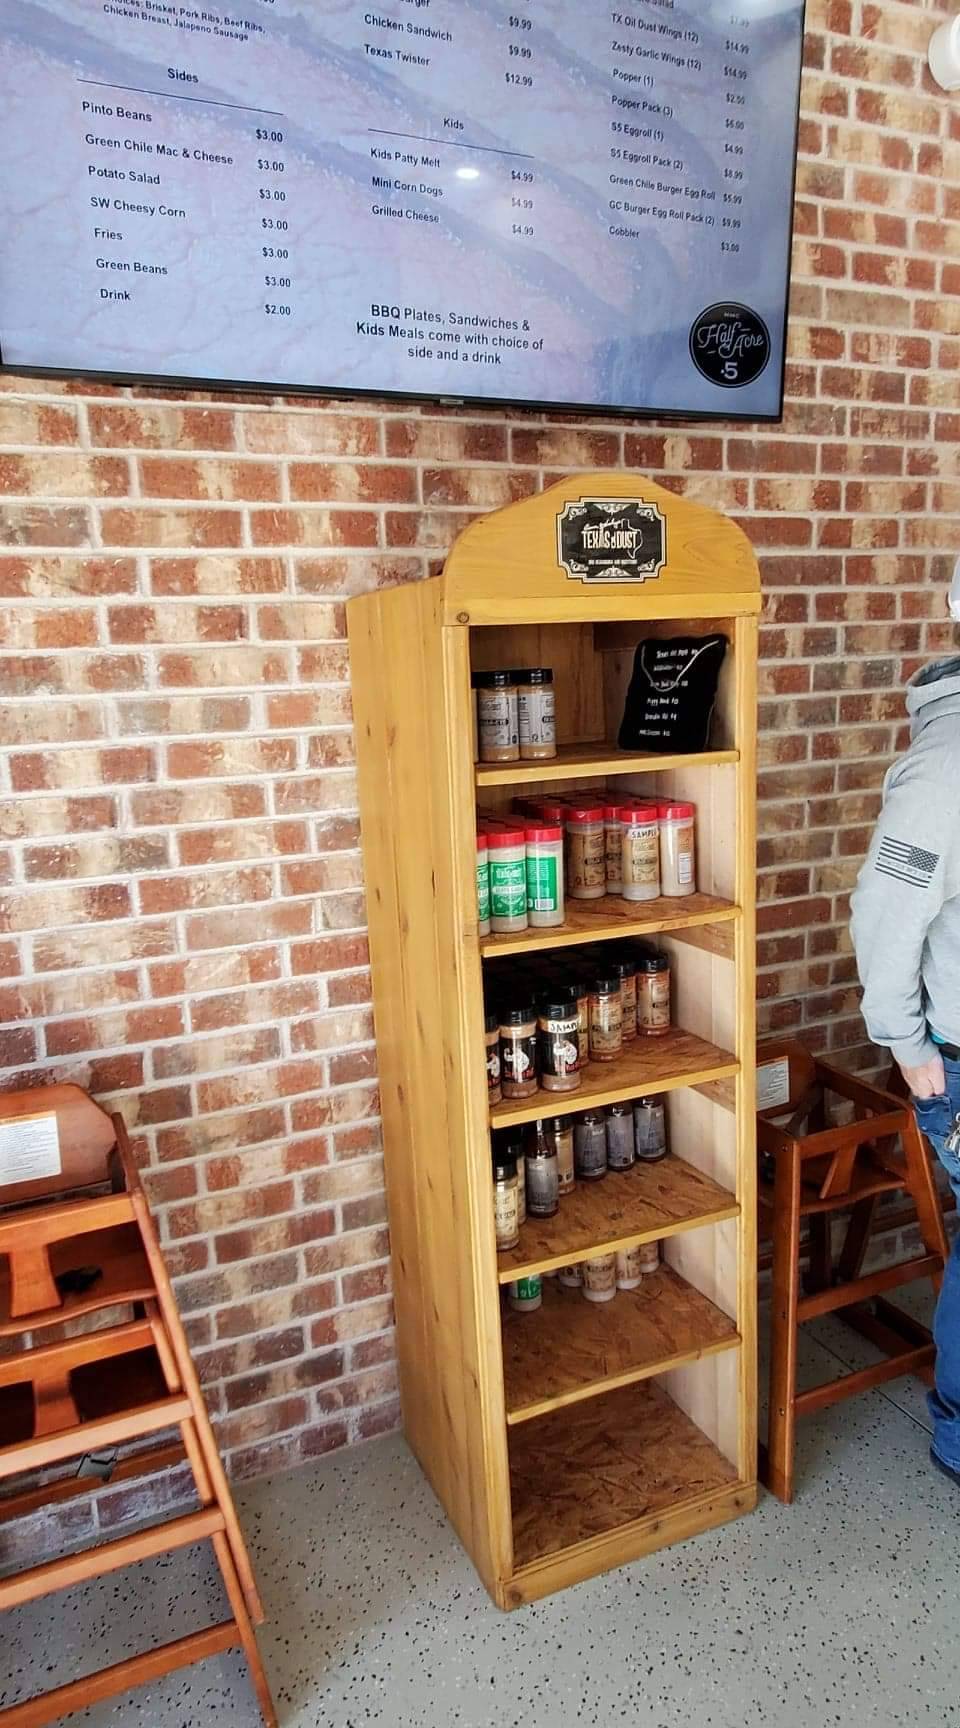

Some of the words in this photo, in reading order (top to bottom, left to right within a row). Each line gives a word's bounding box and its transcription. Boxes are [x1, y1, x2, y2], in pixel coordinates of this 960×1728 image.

[104, 5, 139, 18] Chicken
[142, 12, 172, 26] Breast,
[174, 19, 211, 33] Jalapeno
[214, 27, 249, 41] Sausage
[146, 1, 178, 16] Brisket,
[180, 8, 199, 18] Pork
[202, 13, 222, 25] Ribs,
[225, 17, 242, 28] Beef
[245, 21, 266, 33] Ribs,
[509, 16, 532, 30] $9.99
[365, 14, 403, 33] Chicken
[407, 20, 452, 41] Sandwich
[611, 13, 622, 25] TX
[624, 16, 635, 28] Oil
[638, 18, 656, 33] Dust
[659, 23, 682, 40] Wings
[685, 30, 698, 43] (12)
[364, 44, 392, 59] Texas
[397, 51, 430, 66] Twister
[509, 45, 531, 59] $9.99
[612, 41, 633, 57] Zesty
[636, 45, 658, 61] Garlic
[661, 51, 685, 67] Wings
[687, 58, 701, 70] (12)
[168, 68, 198, 83] Sides
[505, 73, 532, 86] $12.99
[613, 69, 641, 84] Popper
[644, 75, 653, 87] (1)
[82, 102, 113, 117] Pinto
[117, 107, 152, 122] Beans
[612, 96, 640, 111] Popper
[642, 101, 660, 113] Pack
[663, 106, 673, 117] (3)
[444, 118, 464, 130] Kids
[256, 129, 283, 143] $3.00
[624, 125, 652, 140] Eggroll
[654, 130, 663, 142] (1)
[86, 134, 120, 148] Green
[125, 139, 153, 153] Chile
[157, 145, 178, 157] Mac
[183, 148, 190, 159] &
[194, 150, 233, 165] Cheese
[371, 148, 392, 161] Kids
[395, 152, 418, 167] Patty
[421, 156, 440, 168] Melt
[258, 159, 284, 172] $3.00
[623, 151, 650, 166] Eggroll
[653, 156, 671, 168] Pack
[674, 160, 683, 171] (2)
[88, 165, 125, 180] Potato
[129, 170, 160, 185] Salad
[512, 170, 533, 183] $4.99
[260, 189, 285, 201] $3.00
[372, 177, 392, 189] Mini
[394, 181, 416, 192] Corn
[420, 185, 443, 197] Dogs
[610, 174, 633, 187] Green
[636, 179, 655, 191] Chile
[657, 182, 682, 197] Burger
[685, 187, 699, 199] Egg
[701, 190, 715, 200] Roll
[90, 197, 110, 209] SW
[114, 200, 155, 217] Cheesy
[159, 206, 186, 218] Corn
[512, 198, 533, 209] $4.99
[372, 205, 403, 218] Grilled
[406, 210, 439, 223] Cheese
[609, 200, 622, 210] GC
[624, 203, 649, 217] Burger
[653, 207, 667, 219] Egg
[670, 209, 684, 220] Roll
[686, 211, 703, 222] Pack
[705, 215, 714, 226] (2)
[262, 218, 287, 231] $3.00
[512, 225, 533, 236] $4.99
[609, 226, 639, 238] Cobbler
[95, 228, 122, 241] Fries
[262, 247, 288, 259] $3.00
[96, 258, 130, 272] Green
[134, 262, 168, 275] Beans
[265, 276, 291, 288] $3.00
[101, 288, 131, 301] Drink
[265, 304, 291, 316] $2.00
[371, 305, 400, 319] BBQ
[404, 308, 445, 325] Plates,
[449, 313, 518, 330] Sandwiches
[522, 320, 530, 331] &
[357, 322, 384, 336] Kids
[389, 325, 424, 339] Meals
[429, 332, 460, 343] come
[465, 333, 488, 345] with
[492, 336, 528, 349] choice
[532, 339, 543, 350] of
[697, 322, 741, 351] Half
[408, 347, 432, 359] side
[437, 349, 458, 361] and
[462, 354, 468, 362] a
[472, 351, 501, 364] drink
[581, 530, 611, 550] TEXAS
[616, 530, 638, 550] DUST
